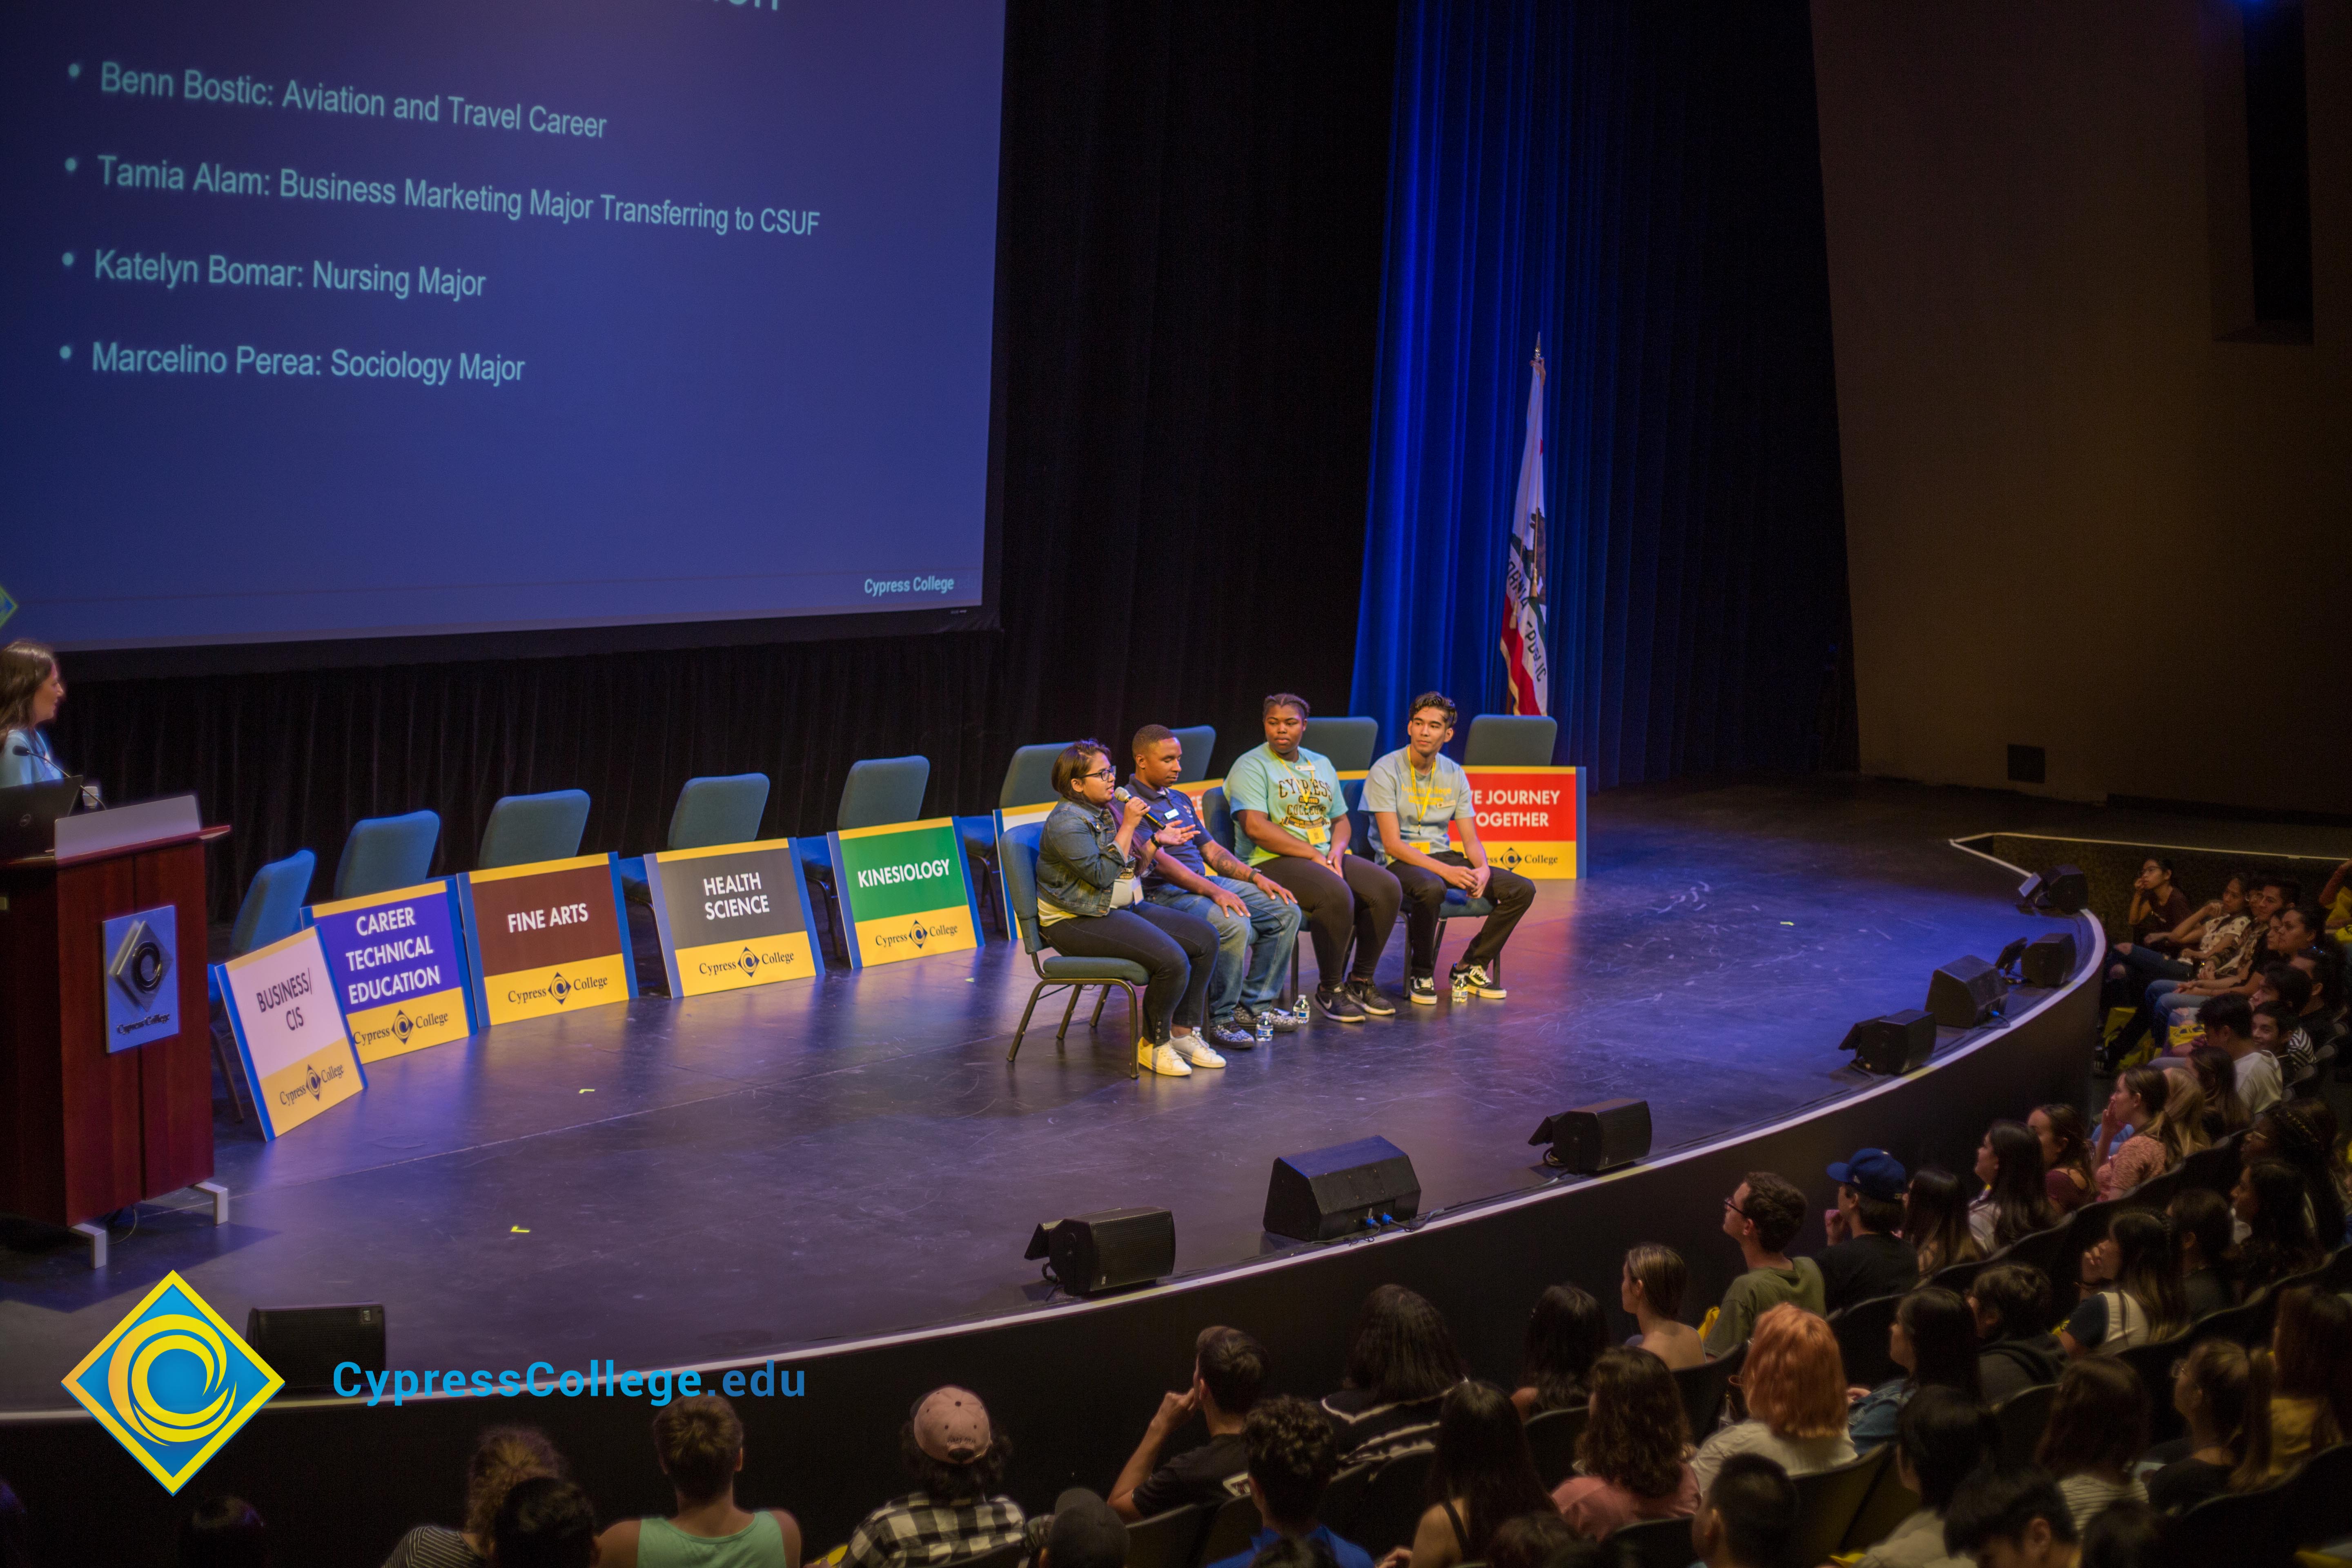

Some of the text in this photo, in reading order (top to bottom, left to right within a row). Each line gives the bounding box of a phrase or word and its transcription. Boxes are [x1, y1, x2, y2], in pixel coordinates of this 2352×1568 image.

[101, 61, 608, 138] Benn Bostic: Aviation and Travel Career
[98, 155, 820, 236] Tamia Alam: Business Marketing Major Transferring to CSUF
[95, 249, 487, 303] Katelyn Bomar: Nursing Major
[93, 341, 526, 388] Marcelino Perea: Sociology Major
[864, 575, 955, 597] Cypress College
[1278, 778, 1332, 802] CYRESS
[1486, 790, 1560, 805] JOURNEY
[1476, 812, 1548, 827] OGETHER
[857, 858, 950, 889] KINESIOLOGY
[1524, 854, 1558, 865] College
[703, 871, 762, 897] HEALTH
[356, 906, 416, 937] CAREER
[508, 902, 589, 933] FINE ARTS
[704, 894, 771, 921] SCIENCE
[875, 924, 958, 948] Cypress College
[345, 935, 434, 972] TECHNICAL
[699, 951, 794, 976] Cypress College
[255, 967, 313, 1013] BUSINESS/
[347, 964, 441, 1005] EDUCATION
[507, 976, 608, 1004] Cypress College
[285, 1006, 305, 1031] CIS
[352, 1013, 449, 1047] Cypress College
[279, 1063, 345, 1107] Cypress College
